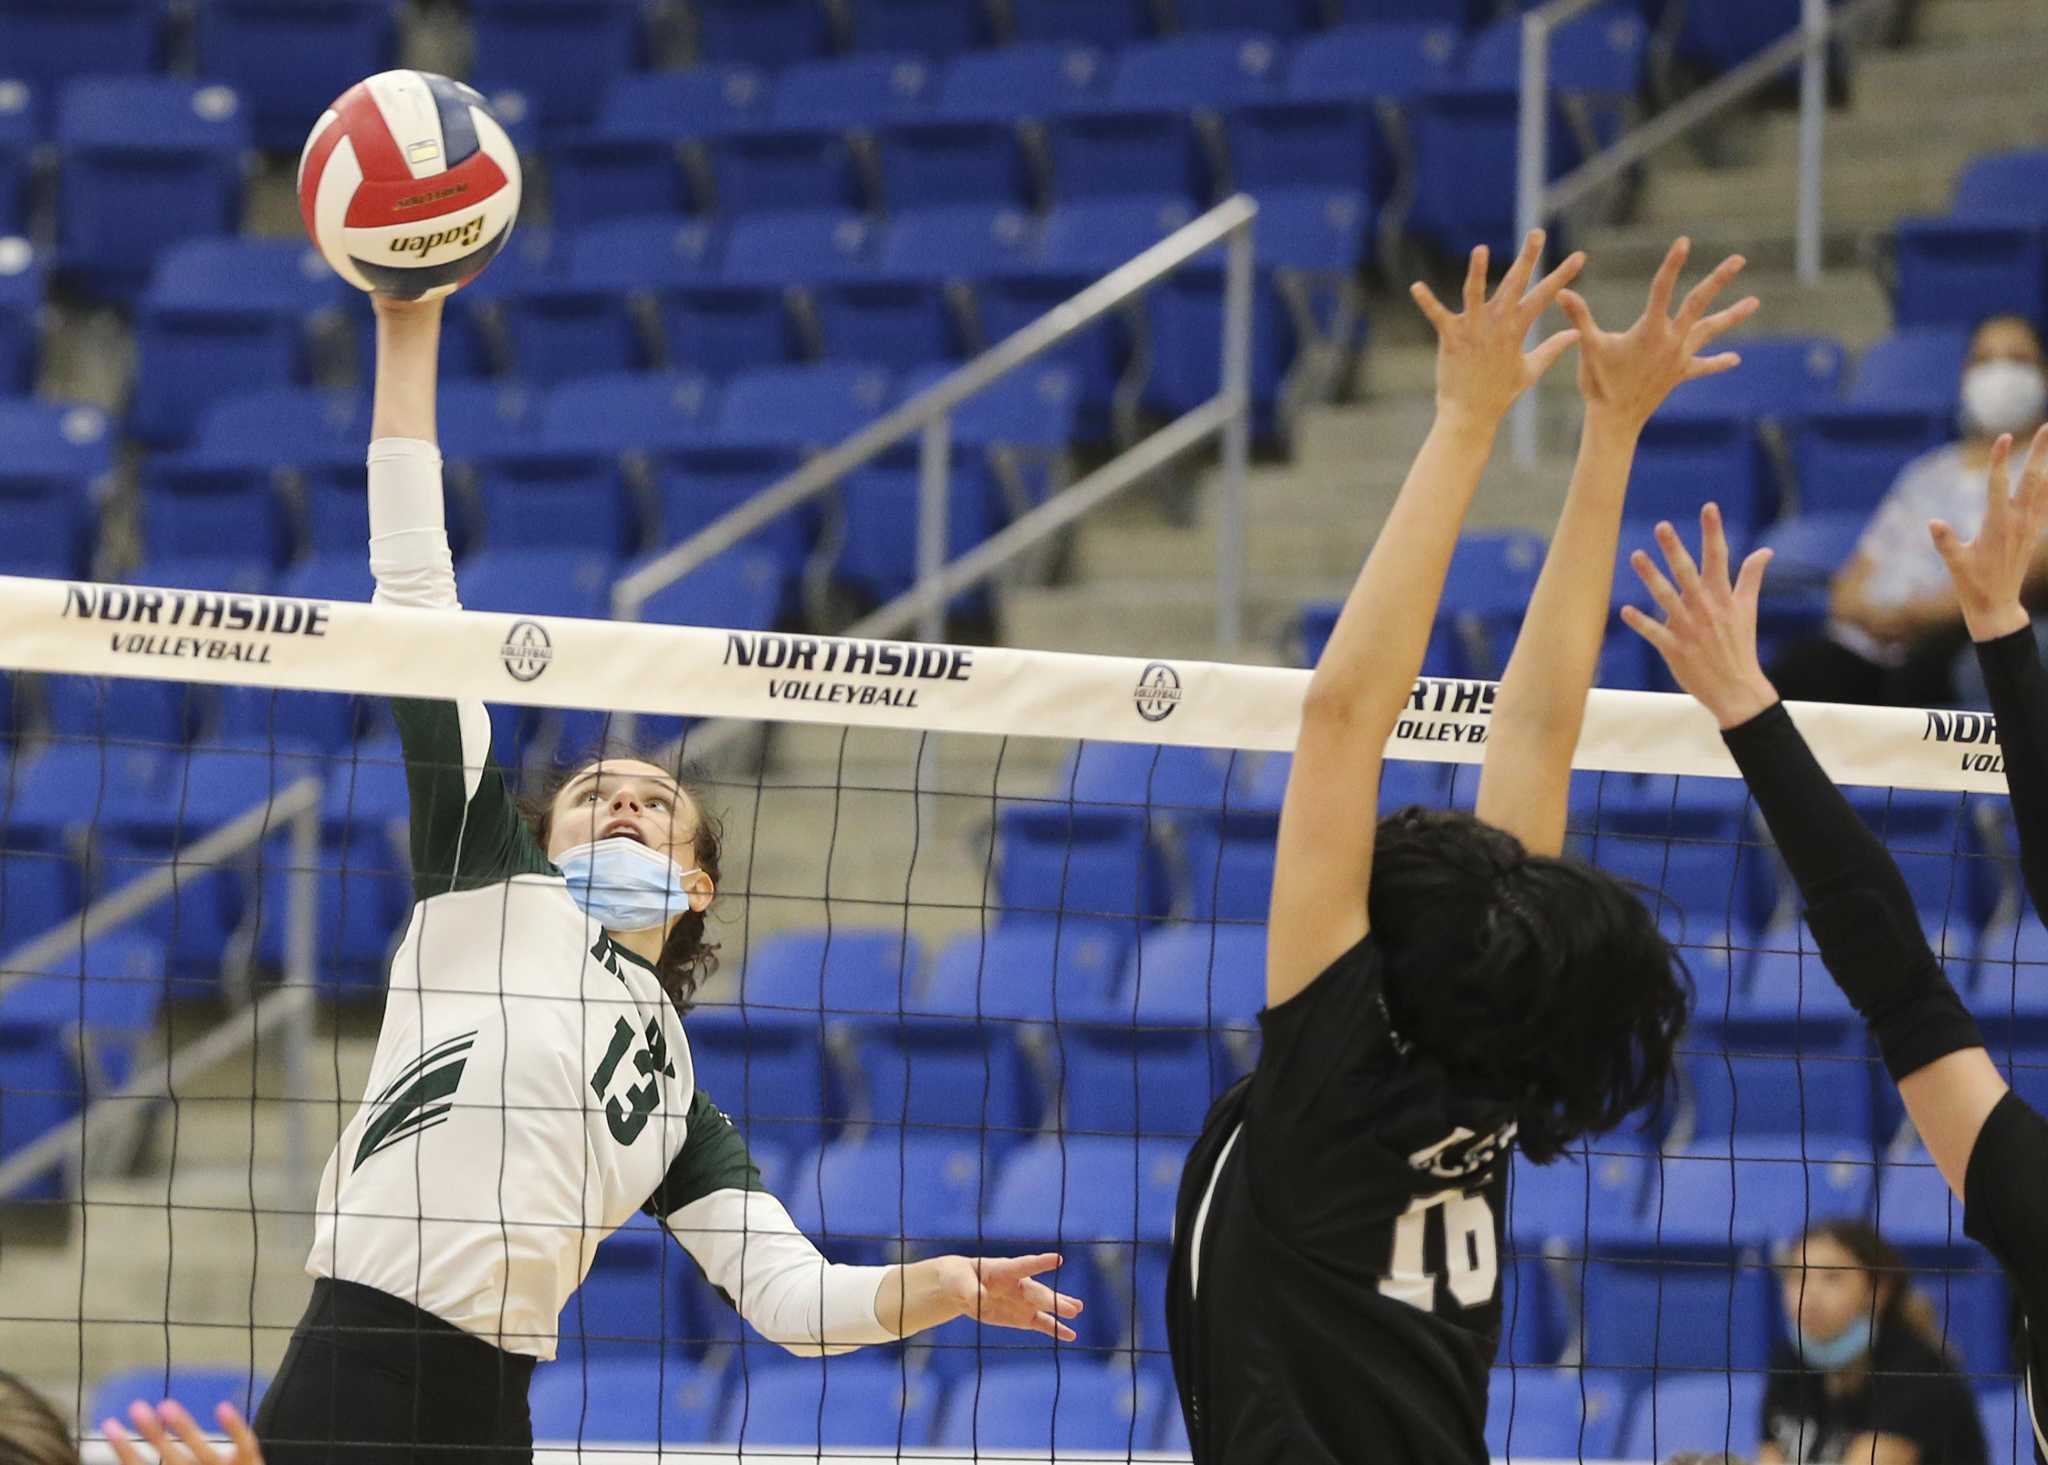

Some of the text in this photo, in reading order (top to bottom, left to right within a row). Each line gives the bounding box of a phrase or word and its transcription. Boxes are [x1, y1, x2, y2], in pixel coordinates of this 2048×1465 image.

[390, 214, 484, 258] Baden
[62, 584, 331, 637] NORTHSIDE
[109, 632, 273, 665] VOLLEYBALL
[723, 634, 974, 682] NORTHSIDE
[768, 678, 921, 709] VOLLEYBALL
[1397, 720, 1488, 743] OLLEYB
[1961, 753, 2006, 773] VOL
[591, 1015, 660, 1146] 13
